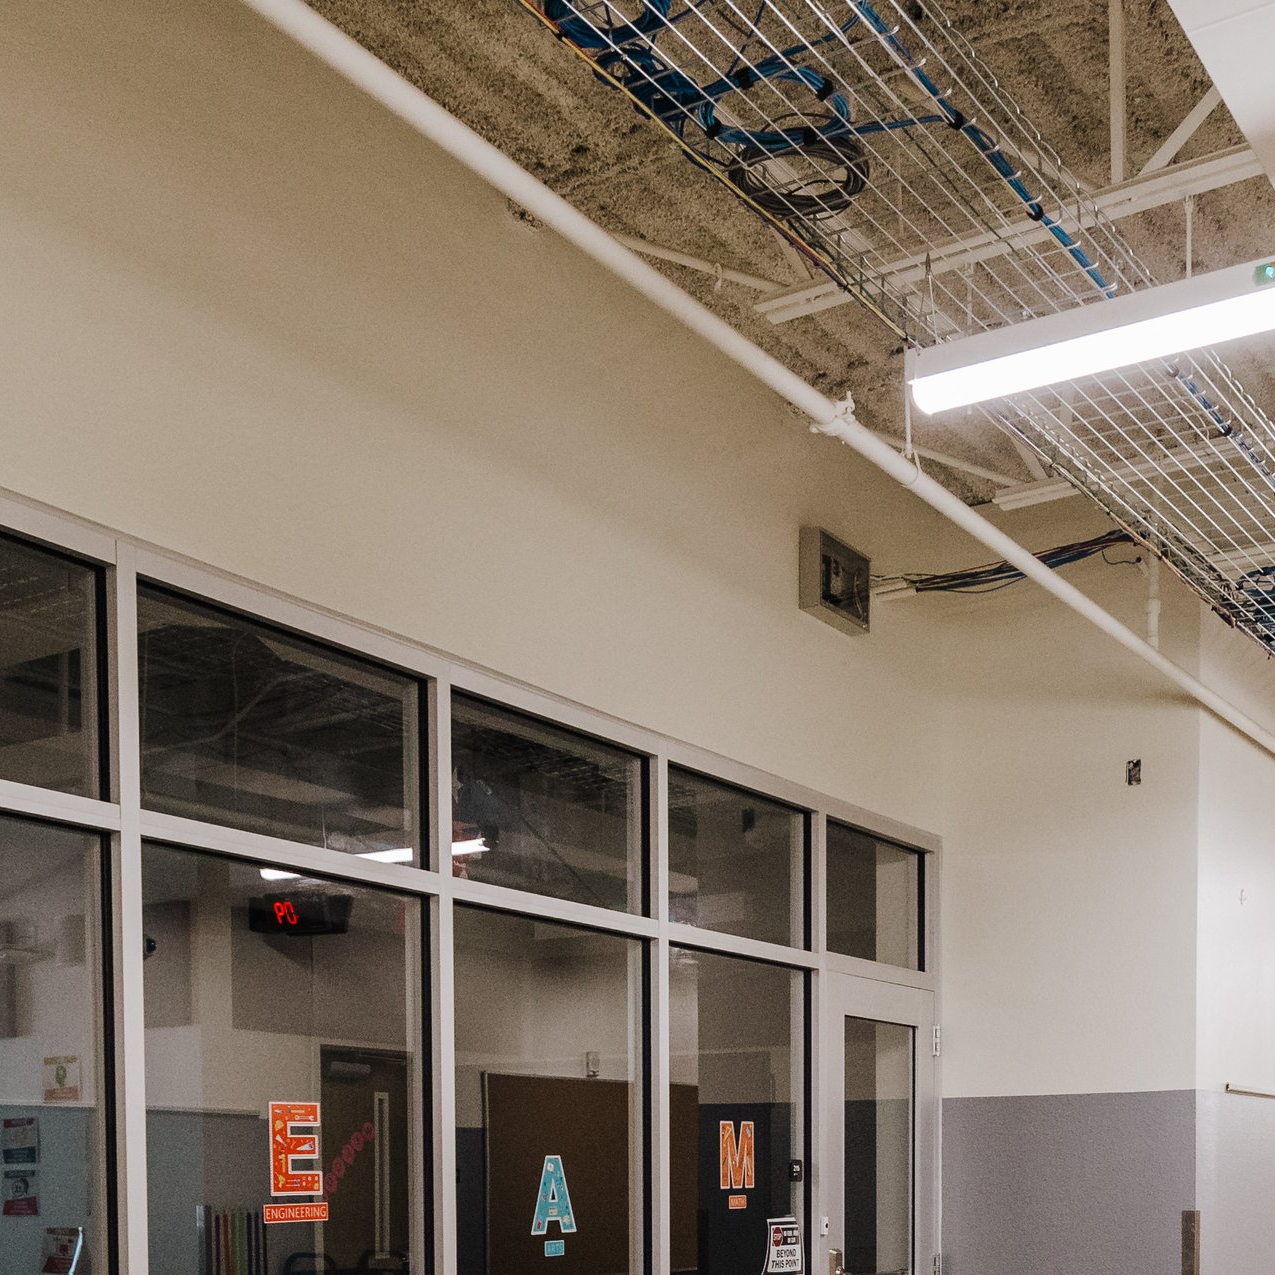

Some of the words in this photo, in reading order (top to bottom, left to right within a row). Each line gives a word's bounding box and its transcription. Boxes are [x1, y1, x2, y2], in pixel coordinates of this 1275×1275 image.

[268, 1101, 323, 1197] E
[719, 1120, 755, 1189] M
[265, 1206, 327, 1220] ENGINEERING
[530, 1154, 577, 1236] A
[771, 1260, 785, 1269] THIS
[785, 1258, 800, 1268] POINT
[776, 1248, 797, 1259] BEYOND
